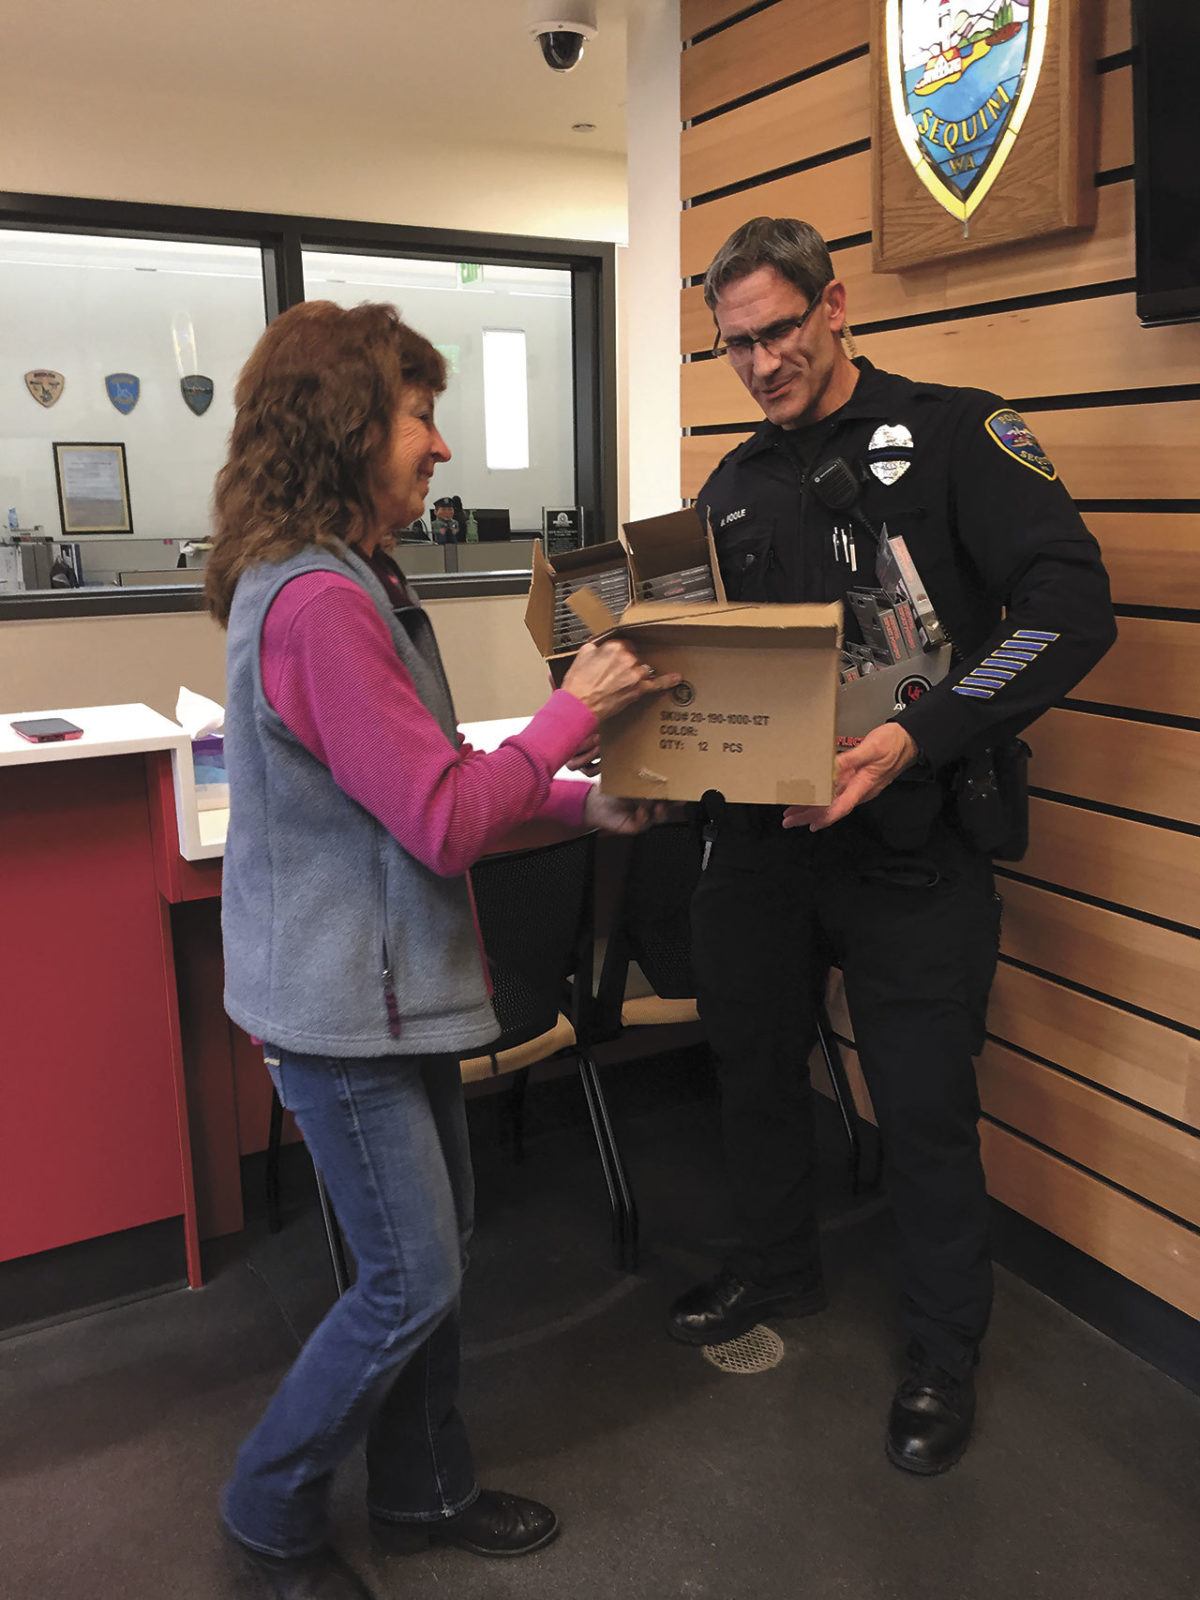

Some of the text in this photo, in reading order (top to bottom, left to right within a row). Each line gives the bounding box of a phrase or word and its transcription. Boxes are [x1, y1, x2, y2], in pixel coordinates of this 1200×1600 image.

[917, 85, 1010, 154] SEQUIM
[660, 724, 698, 737] COLOR:
[698, 741, 709, 752] 12
[722, 742, 744, 753] PCS
